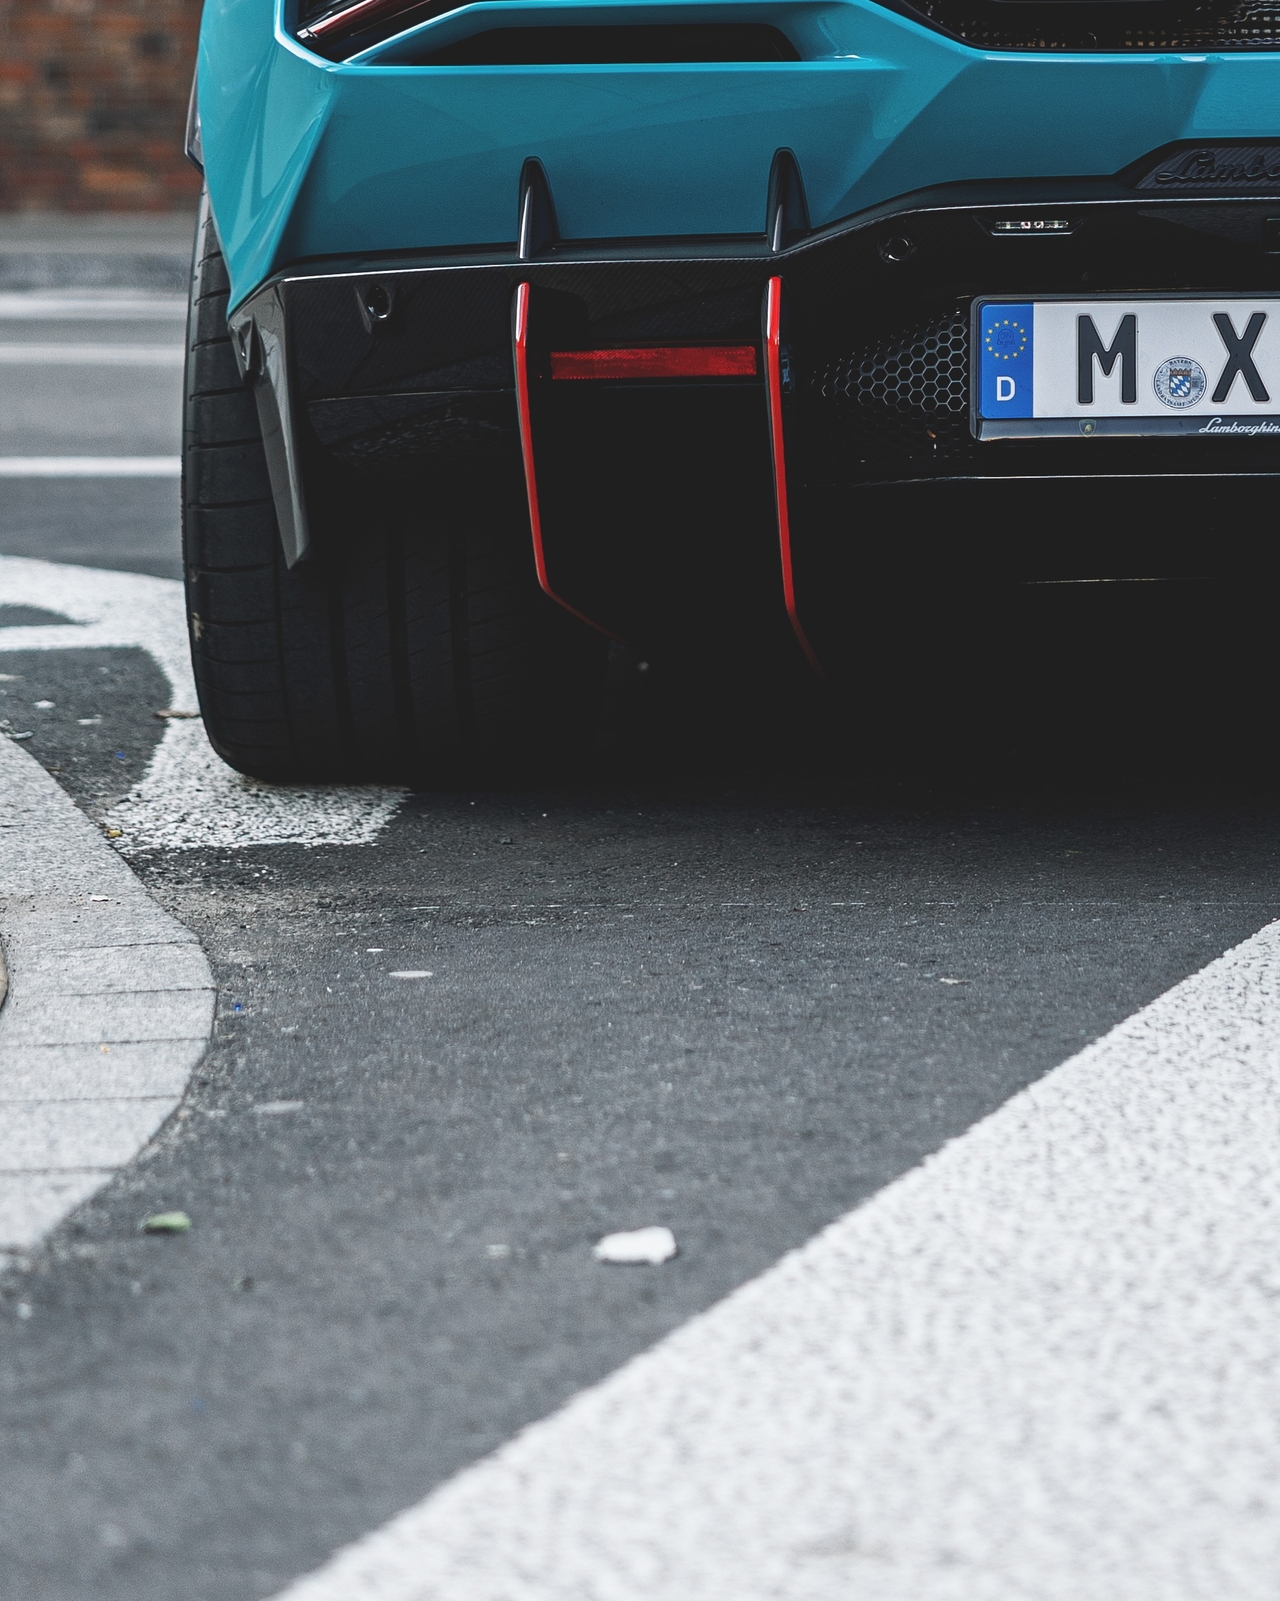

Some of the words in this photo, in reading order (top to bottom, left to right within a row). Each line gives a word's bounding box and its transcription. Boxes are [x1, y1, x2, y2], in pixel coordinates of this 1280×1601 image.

[1076, 313, 1138, 405] M
[1211, 311, 1272, 403] X
[996, 376, 1016, 402] D
